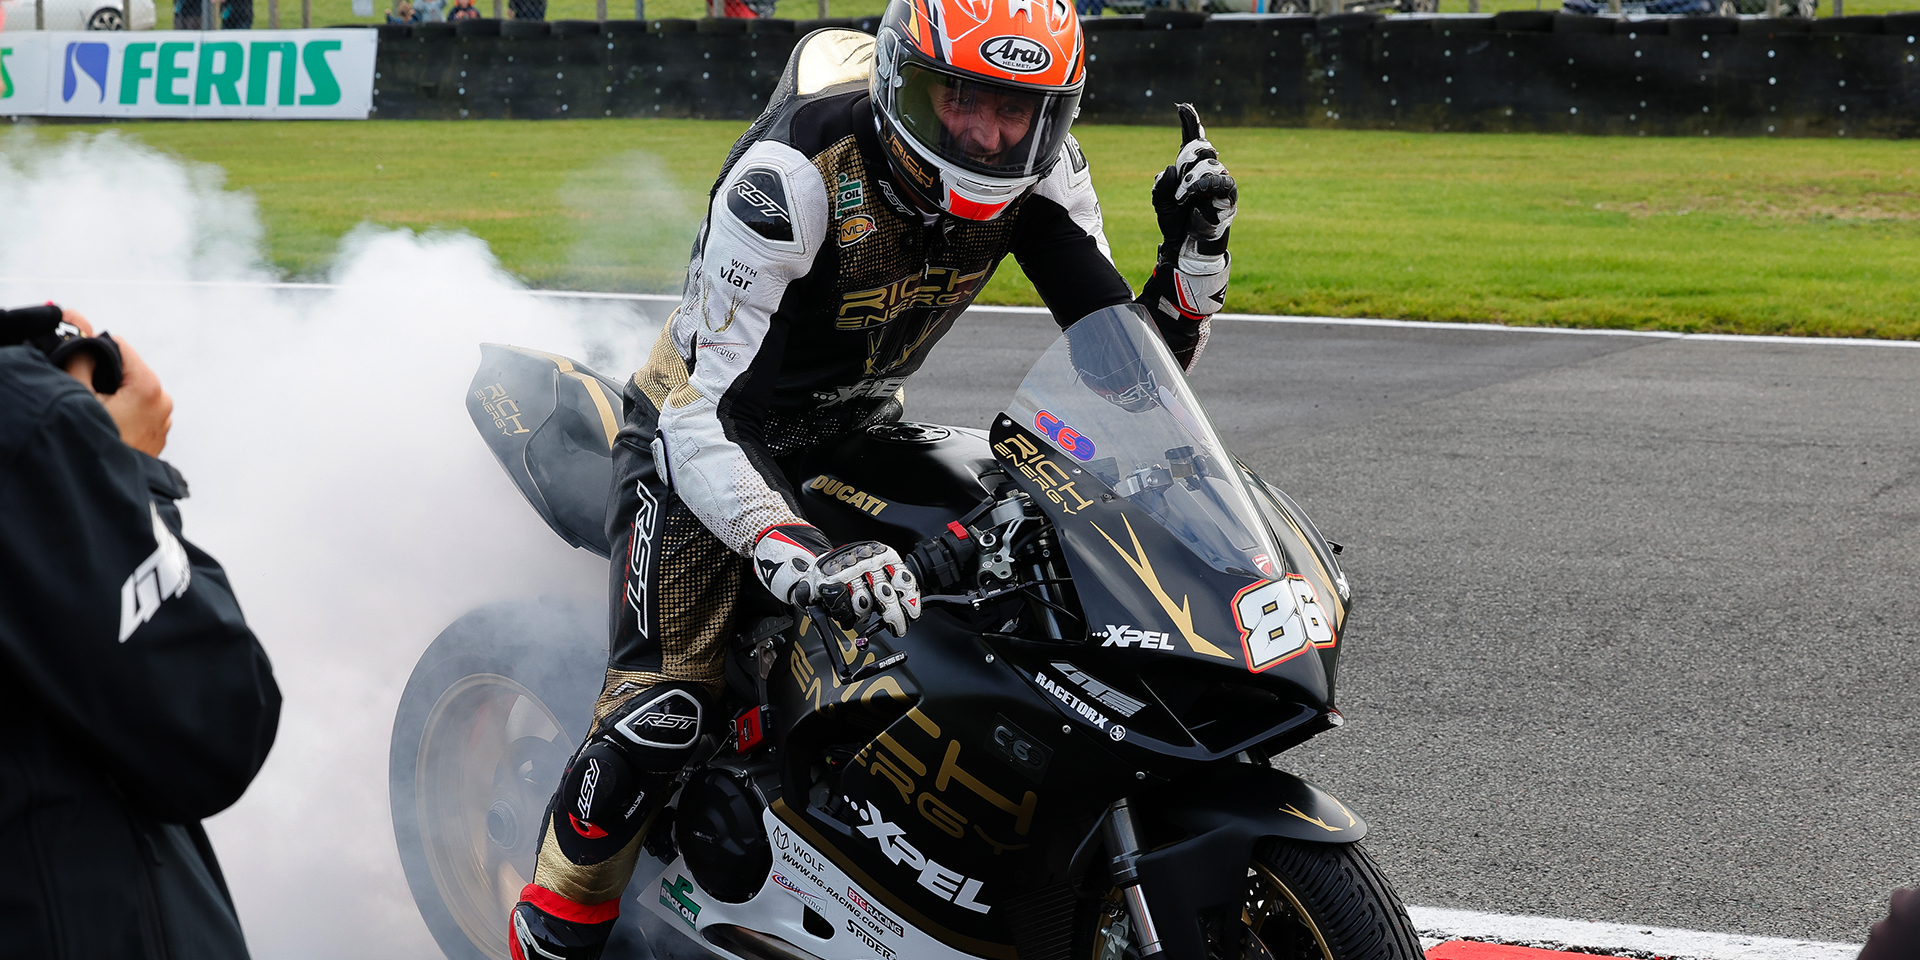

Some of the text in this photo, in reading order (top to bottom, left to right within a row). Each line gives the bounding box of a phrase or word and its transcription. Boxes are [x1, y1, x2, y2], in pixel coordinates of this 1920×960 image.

[119, 40, 342, 106] FERNS
[987, 39, 1044, 65] Arai
[892, 136, 934, 185] RICH
[731, 179, 790, 223] RST
[845, 189, 861, 200] OIL
[878, 180, 915, 216] RST
[731, 258, 758, 277] WITH
[838, 259, 993, 316] RICH
[474, 389, 512, 436] ENERGY
[484, 382, 530, 433] RICH
[810, 475, 888, 517] DUCATI
[993, 442, 1077, 515] ENERGY
[1004, 433, 1094, 511] RICH
[626, 478, 658, 639] RST
[1101, 625, 1175, 650] XPEL
[1232, 573, 1336, 673] 86
[632, 712, 698, 730] RST
[1035, 671, 1109, 729] RACETORX
[578, 758, 600, 819] RST
[793, 842, 825, 873] WOLF
[856, 799, 991, 915] XPEL
[660, 886, 696, 925] ROCK OIL
[782, 851, 884, 936] WWW.RG-RACING.COM
[846, 918, 899, 960] SPIDER
